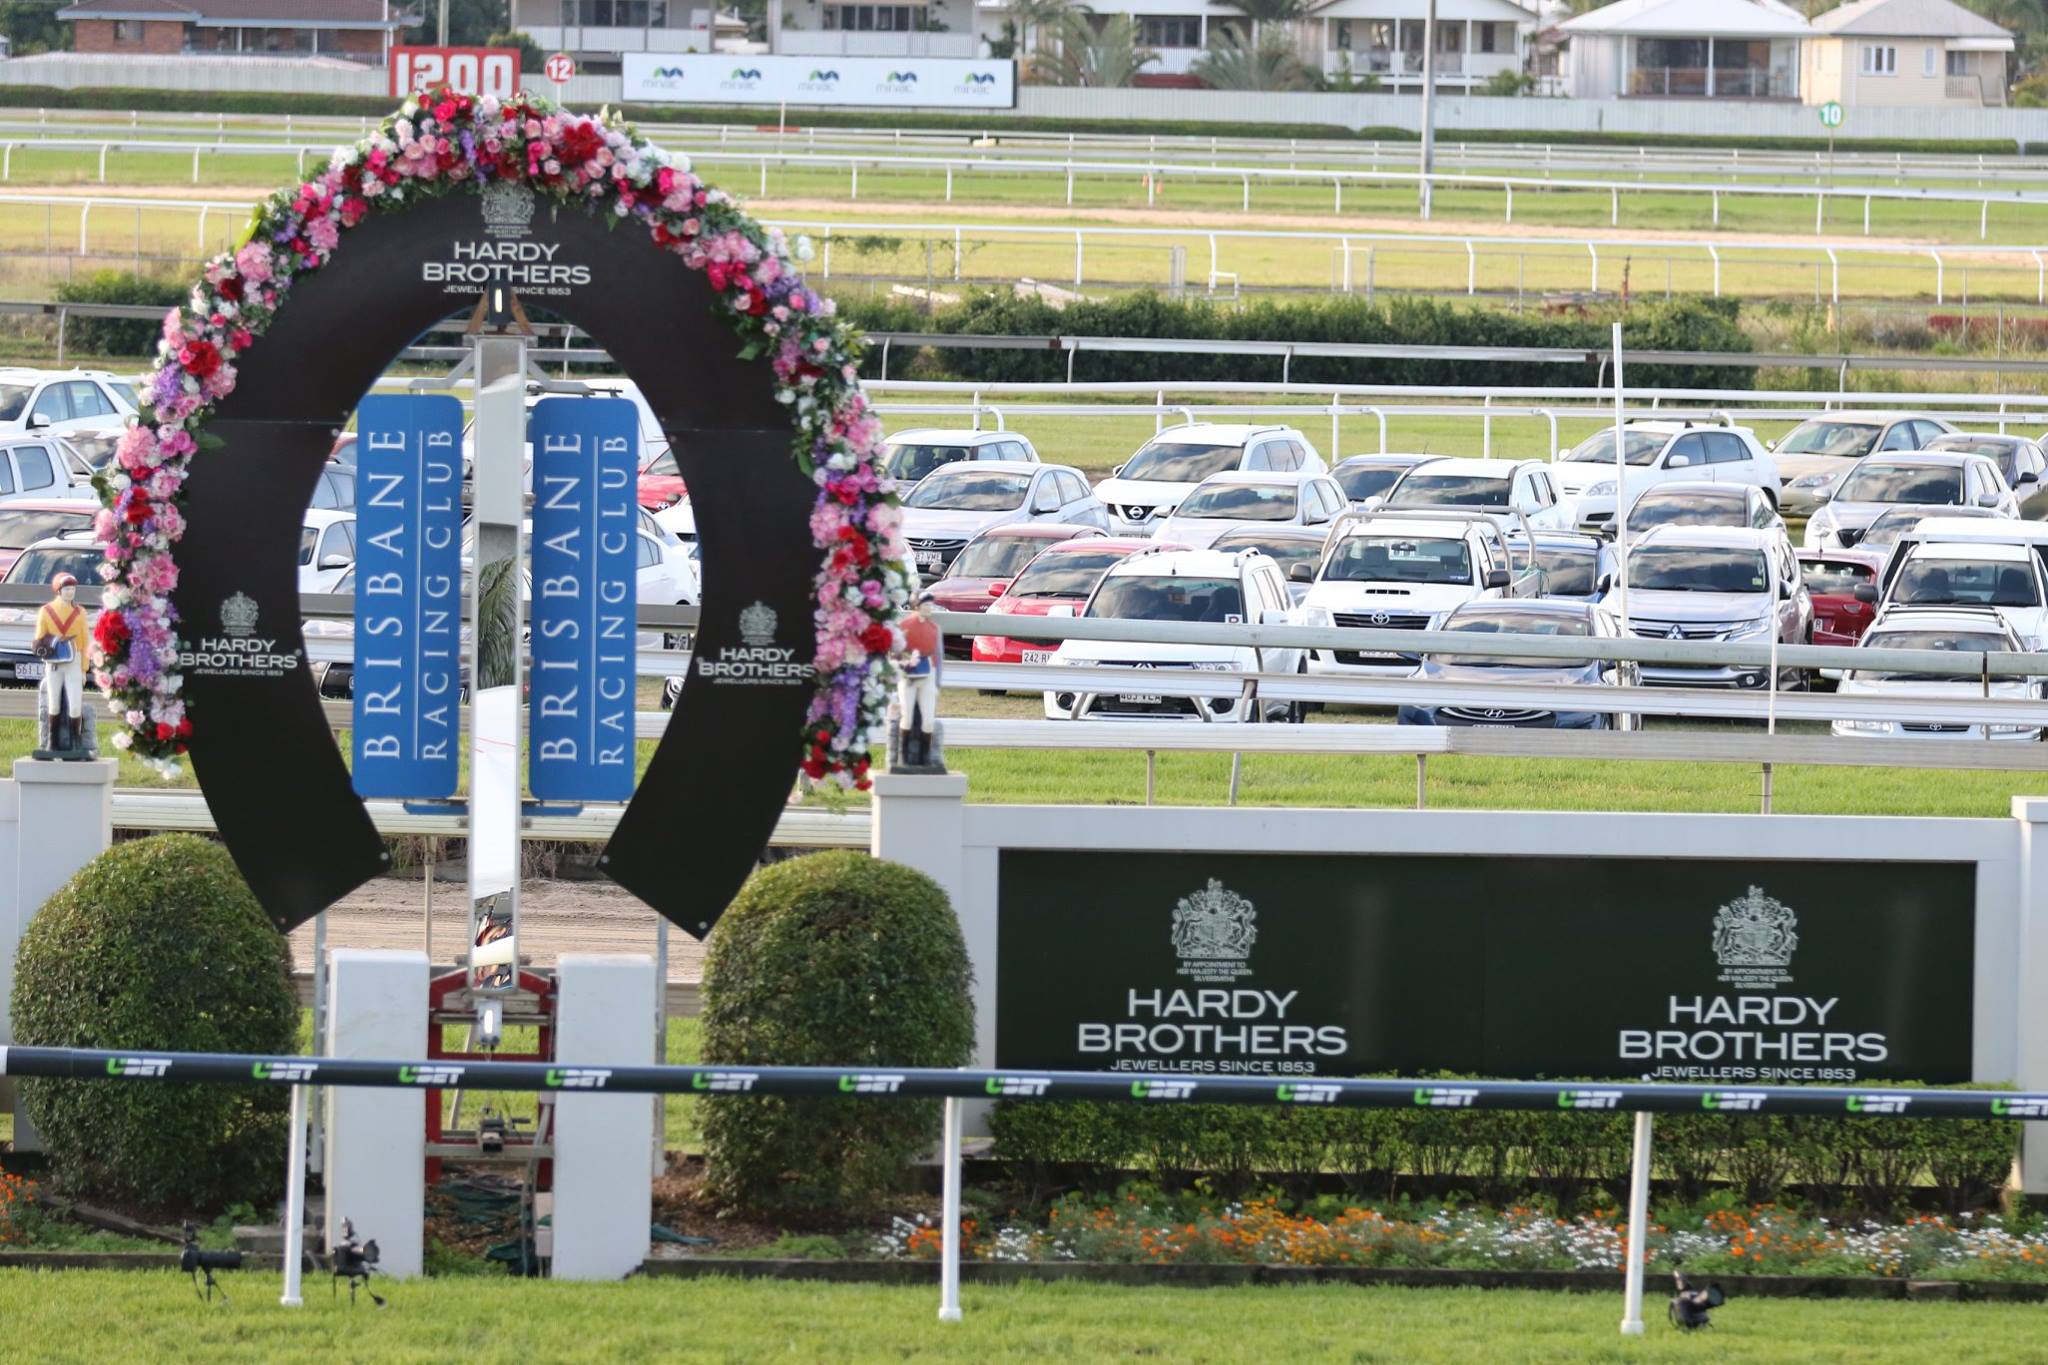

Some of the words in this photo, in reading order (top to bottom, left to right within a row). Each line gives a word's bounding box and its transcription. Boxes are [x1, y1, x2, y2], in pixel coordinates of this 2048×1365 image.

[396, 53, 513, 98] 1200
[549, 58, 572, 80] 12
[1820, 103, 1841, 125] 10
[454, 241, 560, 262] HARDY
[423, 263, 591, 285] BROTHERS
[443, 285, 485, 294] JEWELL
[513, 286, 545, 295] SINCE
[425, 430, 454, 550] CLUB
[601, 435, 629, 554] CLUB
[363, 430, 406, 760] BRISBANE
[540, 432, 582, 763] BRISBANE
[201, 638, 276, 653] HARDY
[720, 647, 795, 662] HARDY
[180, 653, 298, 669] BROTHERS
[422, 574, 451, 761] RACING
[698, 662, 816, 677] BROTHERS
[599, 579, 628, 765] RACING
[1128, 988, 1298, 1019] HARDY
[1669, 995, 1839, 1026] HARDY
[1078, 1023, 1348, 1055] BROTHERS
[1619, 1030, 1888, 1062] BROTHERS
[106, 1058, 172, 1075] UBET
[252, 1062, 318, 1080] UBET
[399, 1066, 465, 1084] UBET
[1110, 1059, 1216, 1072] JEWELLERS
[1219, 1060, 1274, 1073] SINCE
[1277, 1061, 1316, 1073] 1853
[1651, 1066, 1756, 1079] JEWELLERS
[1760, 1067, 1814, 1080] SINCE
[1818, 1068, 1856, 1080] 1853
[545, 1069, 612, 1087] UBET
[692, 1072, 758, 1090] UBET
[839, 1075, 905, 1092] UBET
[986, 1078, 1052, 1095] UBET
[1131, 1081, 1198, 1098] UBET
[1277, 1084, 1343, 1102] UBET
[1413, 1088, 1479, 1105] UBET
[1557, 1090, 1623, 1108] UBET
[1702, 1092, 1767, 1110] UBET
[1847, 1095, 1912, 1112] UBET
